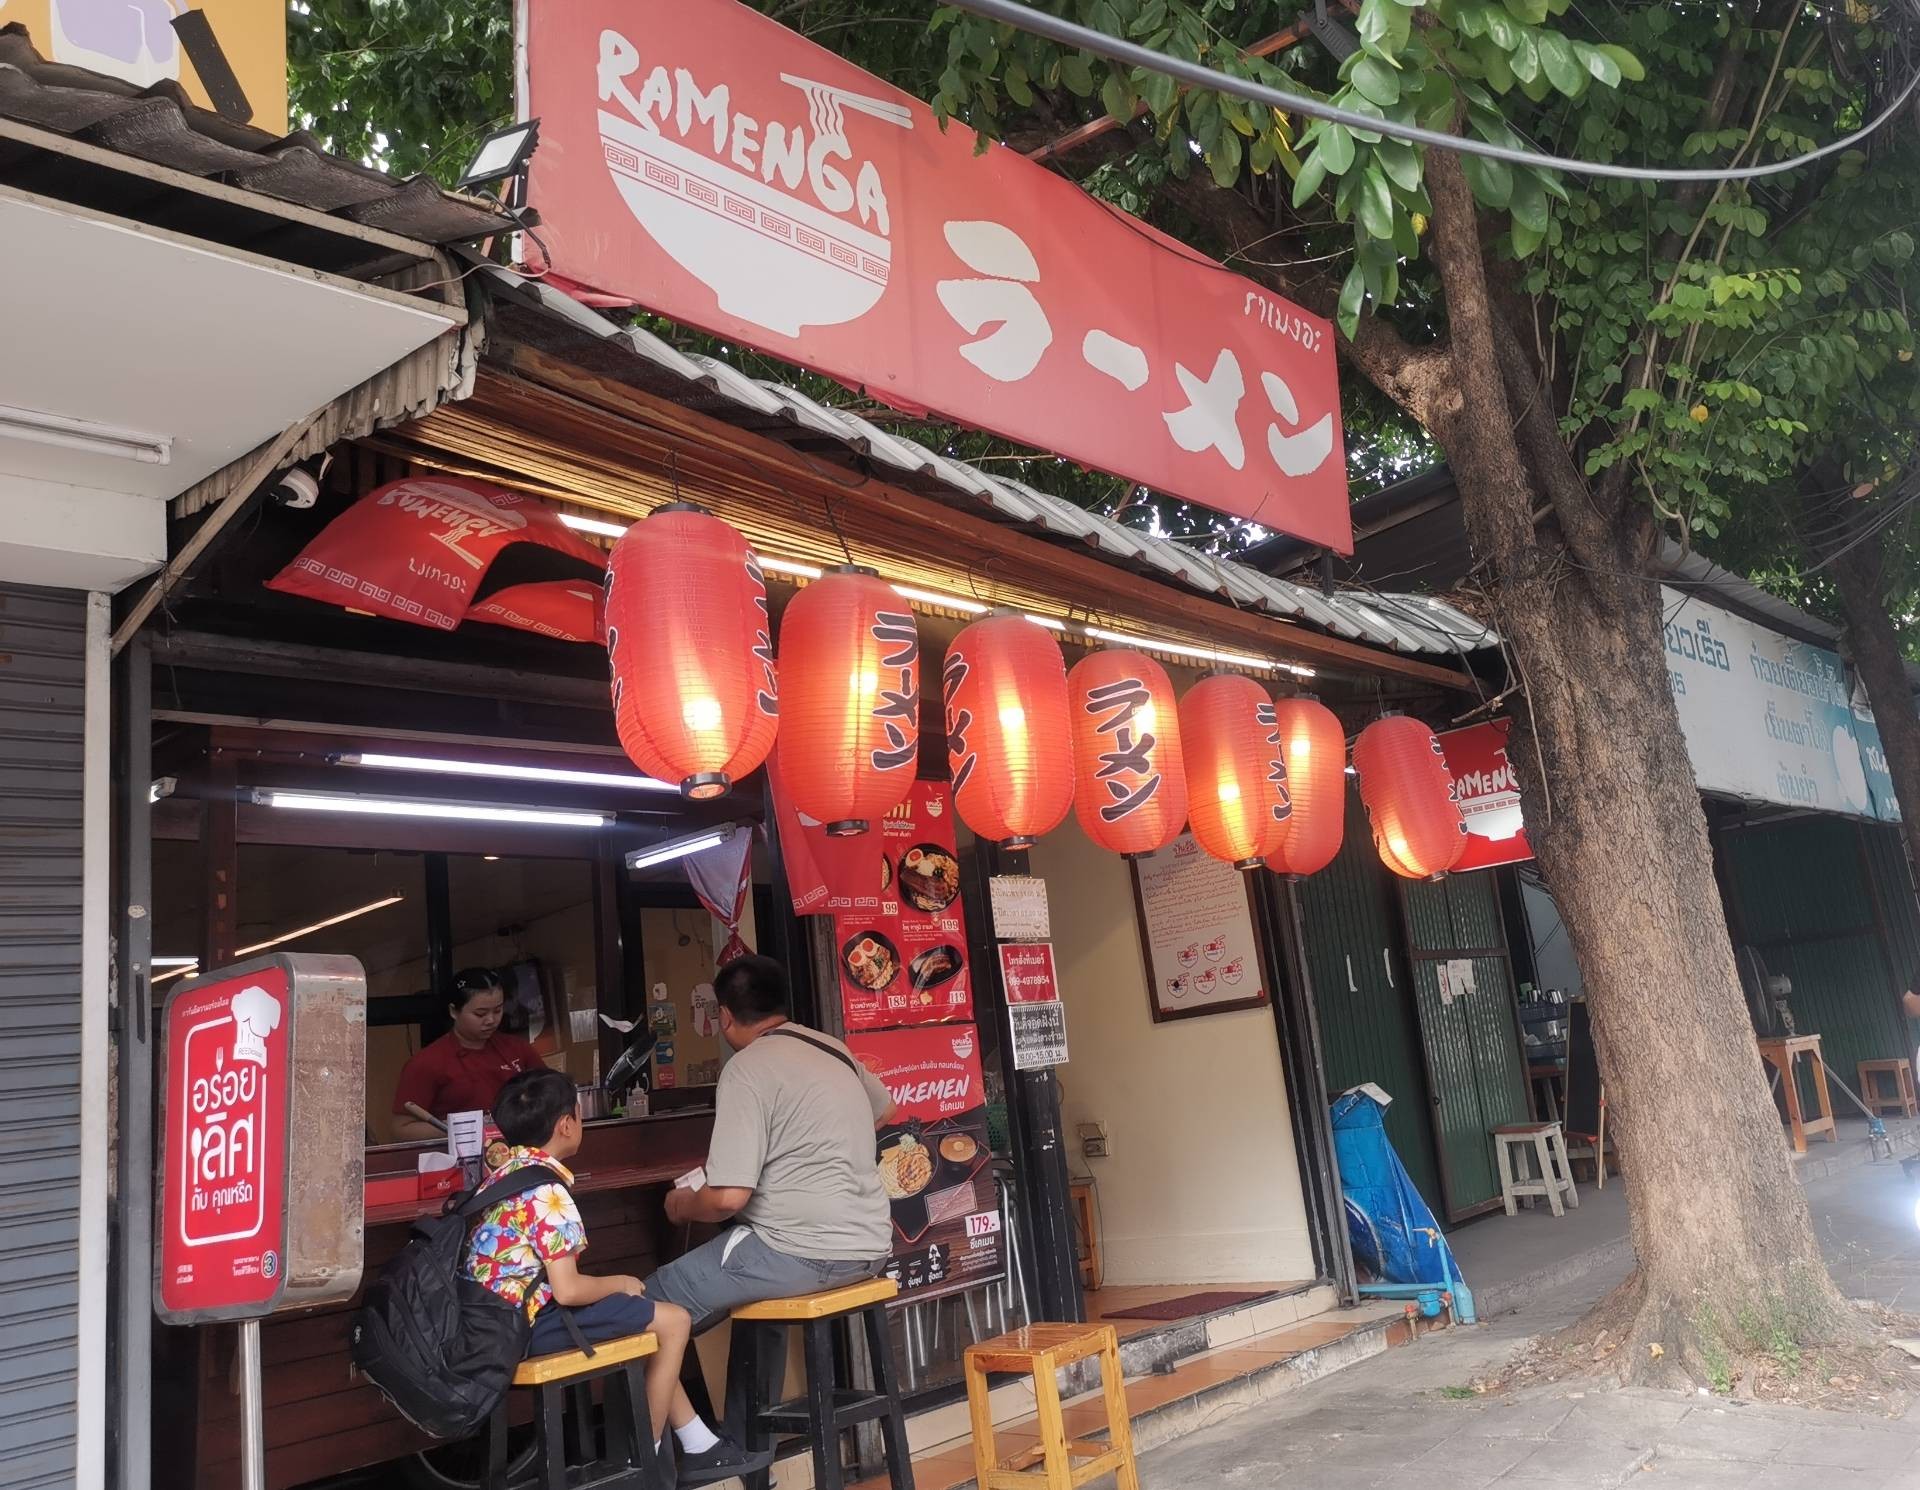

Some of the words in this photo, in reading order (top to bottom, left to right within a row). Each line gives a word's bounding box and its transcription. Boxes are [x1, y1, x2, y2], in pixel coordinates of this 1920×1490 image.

[596, 28, 890, 236] RAMENGA
[936, 220, 1334, 478] ラーメン
[1664, 619, 1730, 671] ยวเรือ
[871, 611, 920, 771] ラーメン
[1085, 678, 1161, 823] ラーメン
[884, 902, 897, 913] 99
[193, 1051, 256, 1113] อร่อย
[191, 1111, 254, 1186] เลิศ
[191, 1188, 208, 1212] กับ
